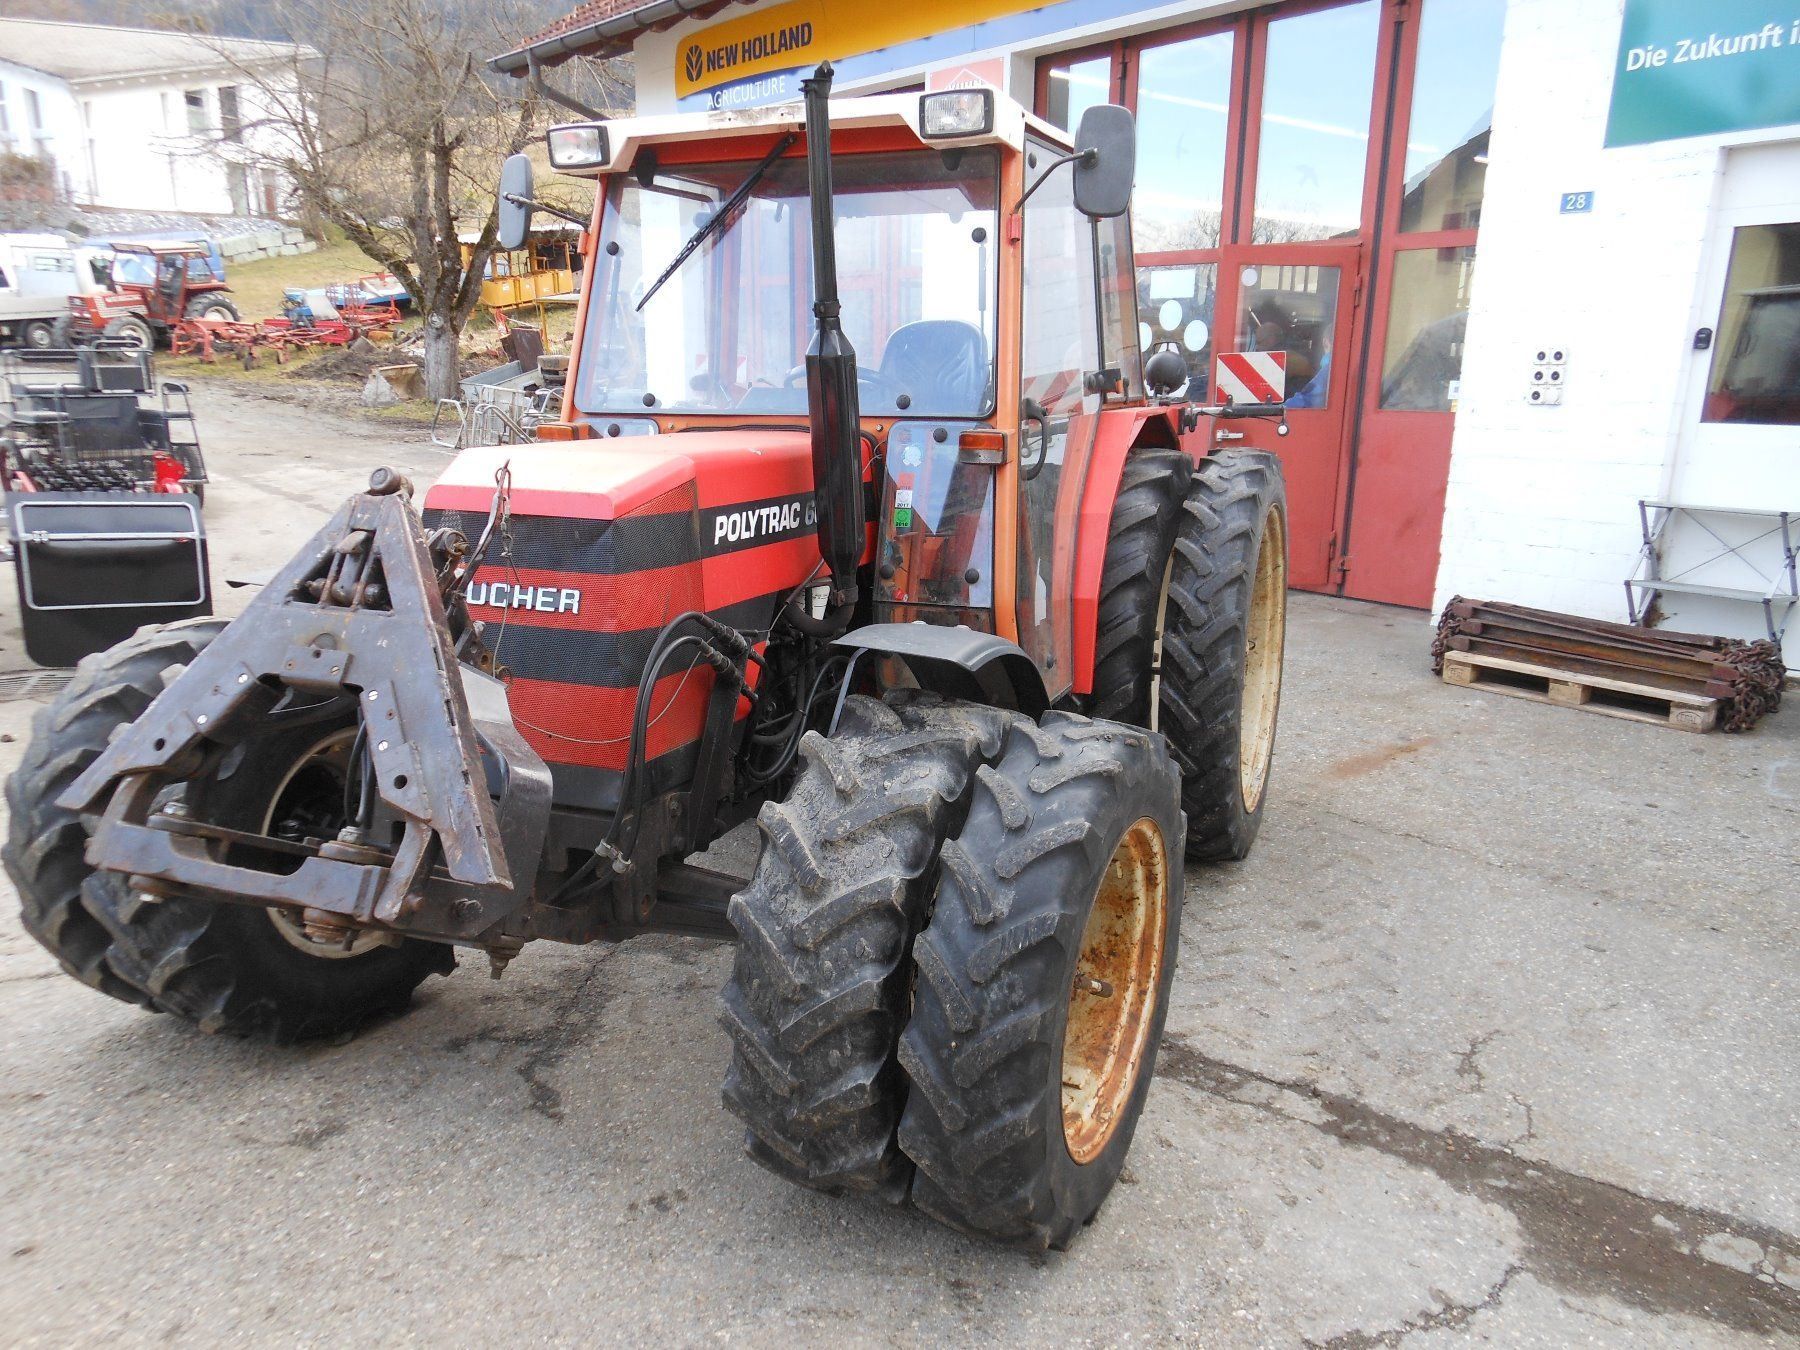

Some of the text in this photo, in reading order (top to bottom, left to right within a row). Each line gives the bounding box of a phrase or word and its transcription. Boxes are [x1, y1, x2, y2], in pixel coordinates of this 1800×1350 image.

[707, 22, 813, 72] NEW HOLLAND
[1626, 19, 1800, 71] Die Zukunft i
[706, 75, 786, 110] AGRICULTURE
[1566, 194, 1586, 210] 28
[714, 501, 801, 545] POLYTRAC
[466, 580, 580, 614] UCHER
